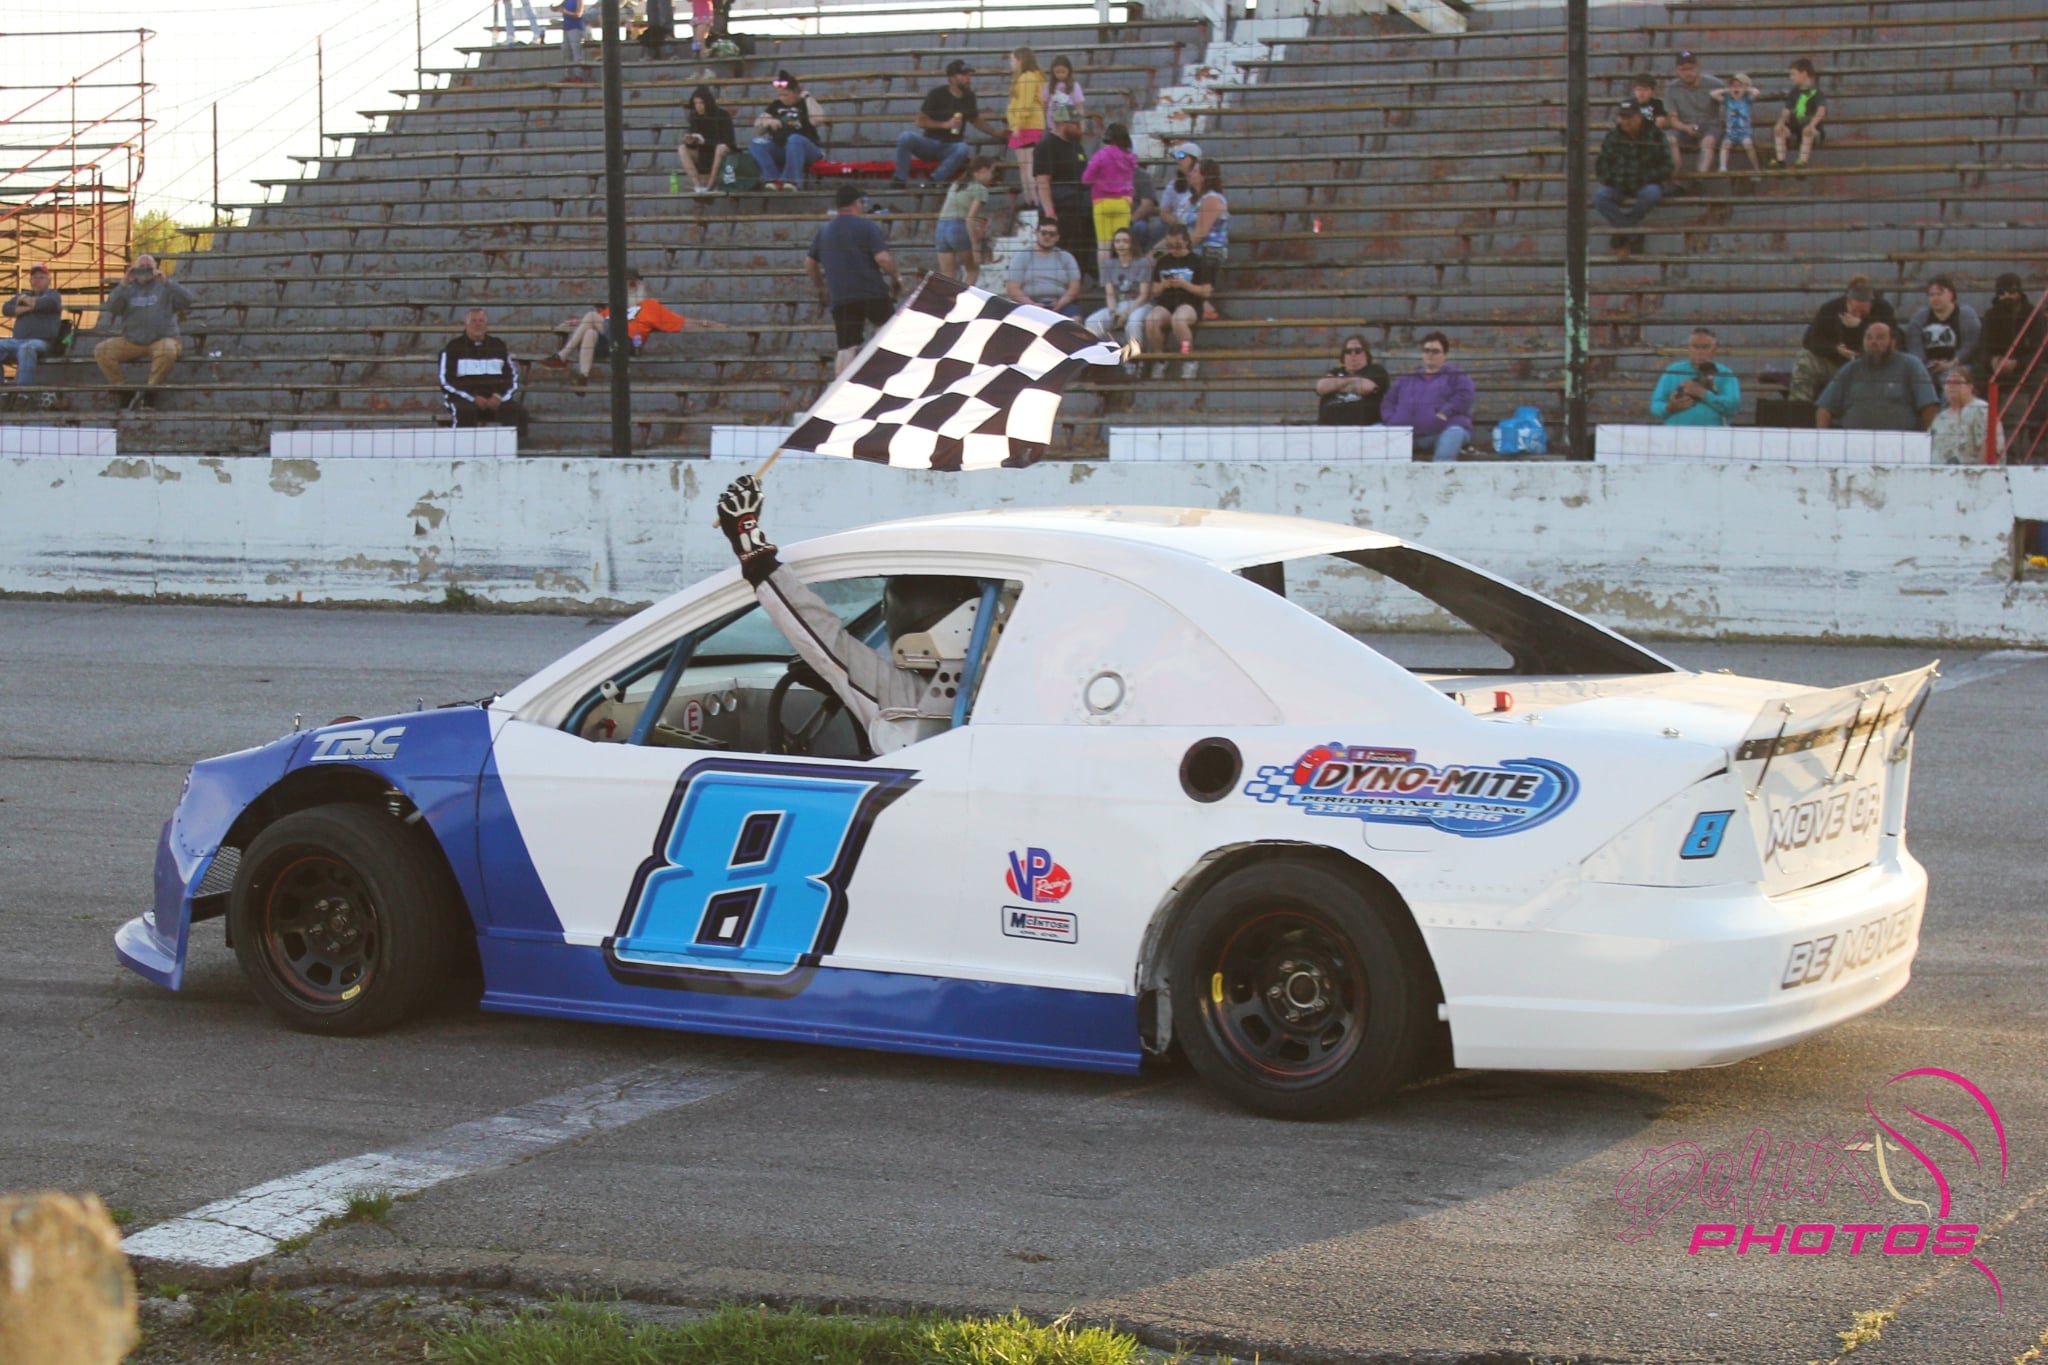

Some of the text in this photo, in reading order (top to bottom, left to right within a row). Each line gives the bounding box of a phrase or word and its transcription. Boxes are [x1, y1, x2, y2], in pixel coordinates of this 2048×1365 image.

[688, 707, 699, 731] E
[310, 726, 406, 760] TRC
[1312, 762, 1541, 801] DYNO-MITE
[1301, 795, 1528, 815] PERFORMANCE TUNING
[1309, 803, 1503, 823] 330-936-9486
[1765, 792, 1850, 862] MOVE
[1680, 809, 1735, 859] 8
[606, 765, 900, 985] 8
[1008, 847, 1052, 902] VP
[1781, 933, 1838, 990] BE
